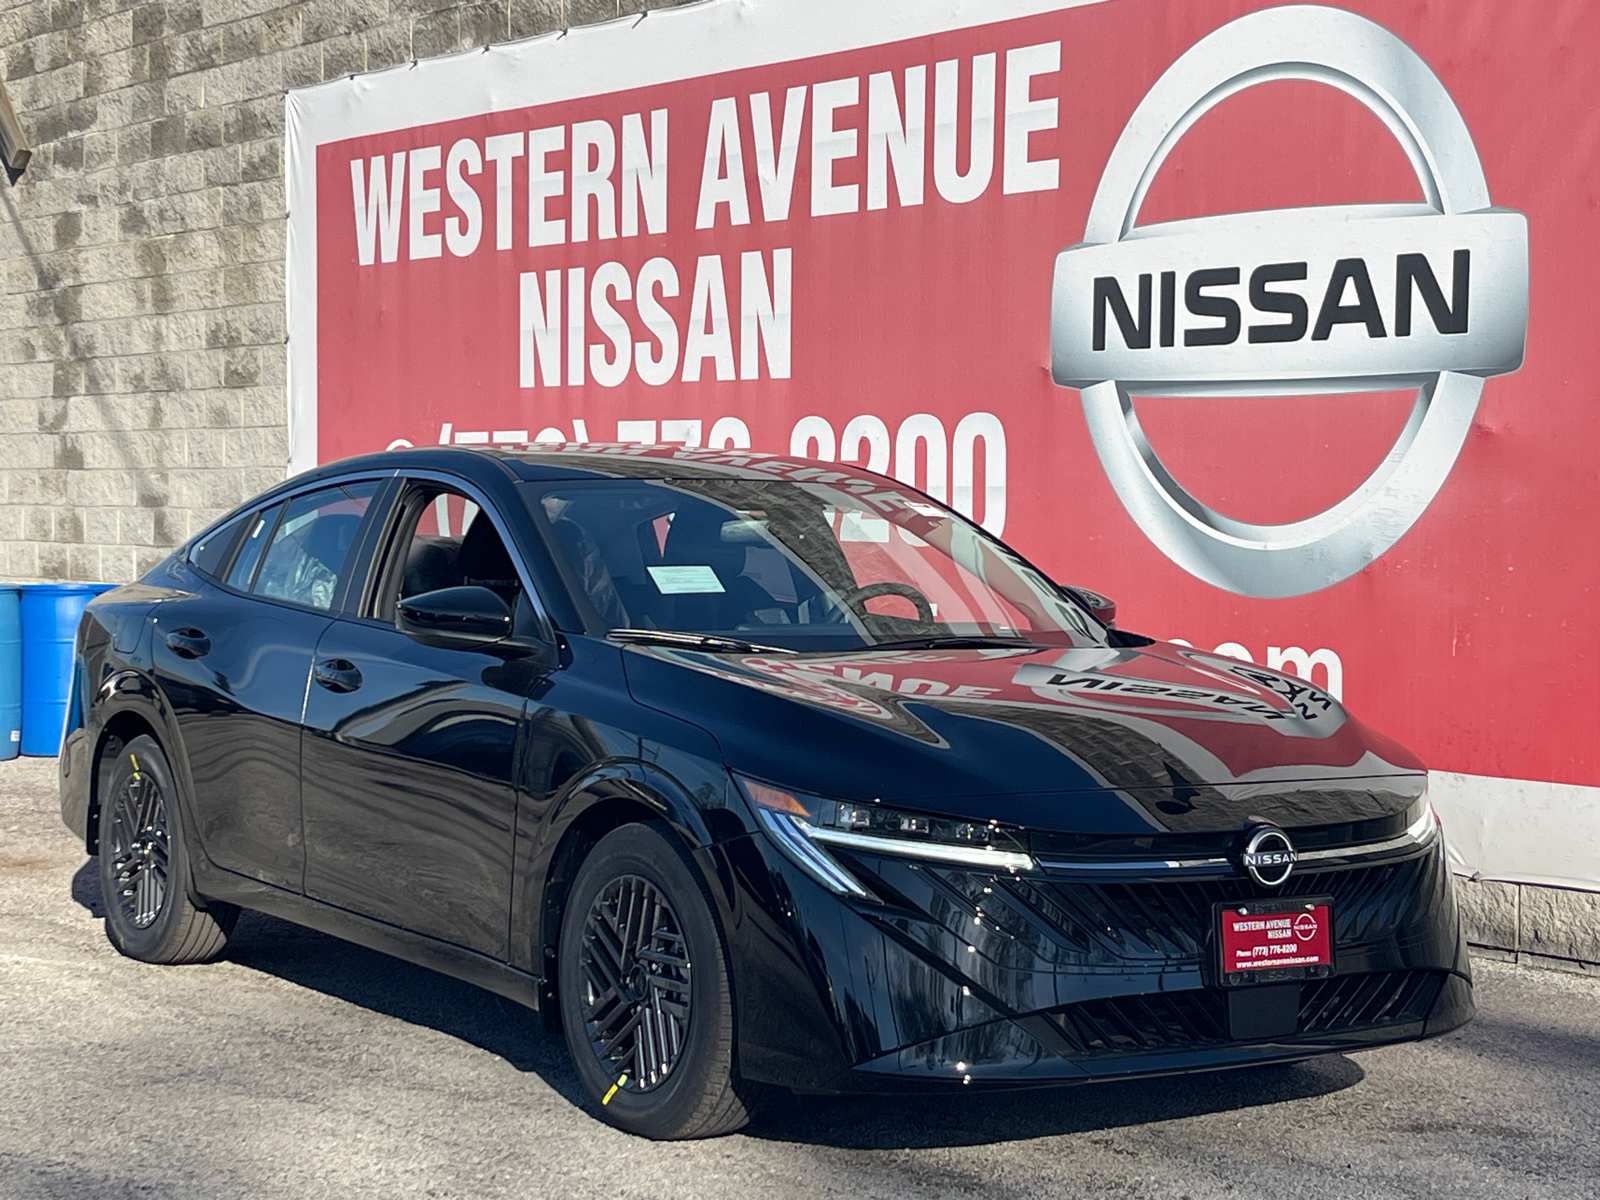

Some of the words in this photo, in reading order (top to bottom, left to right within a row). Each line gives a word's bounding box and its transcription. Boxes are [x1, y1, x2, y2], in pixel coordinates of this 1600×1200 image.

[350, 108, 668, 266] WESTERN
[695, 41, 1062, 230] AVENUE
[1092, 249, 1470, 351] NISSAN
[519, 248, 792, 389] NISSAN
[1245, 852, 1298, 865] NISSAN
[1233, 920, 1265, 932] WESTERN
[1266, 918, 1291, 929] AVENUE
[1267, 929, 1292, 939] NISSAN
[1252, 945, 1268, 958] (773)
